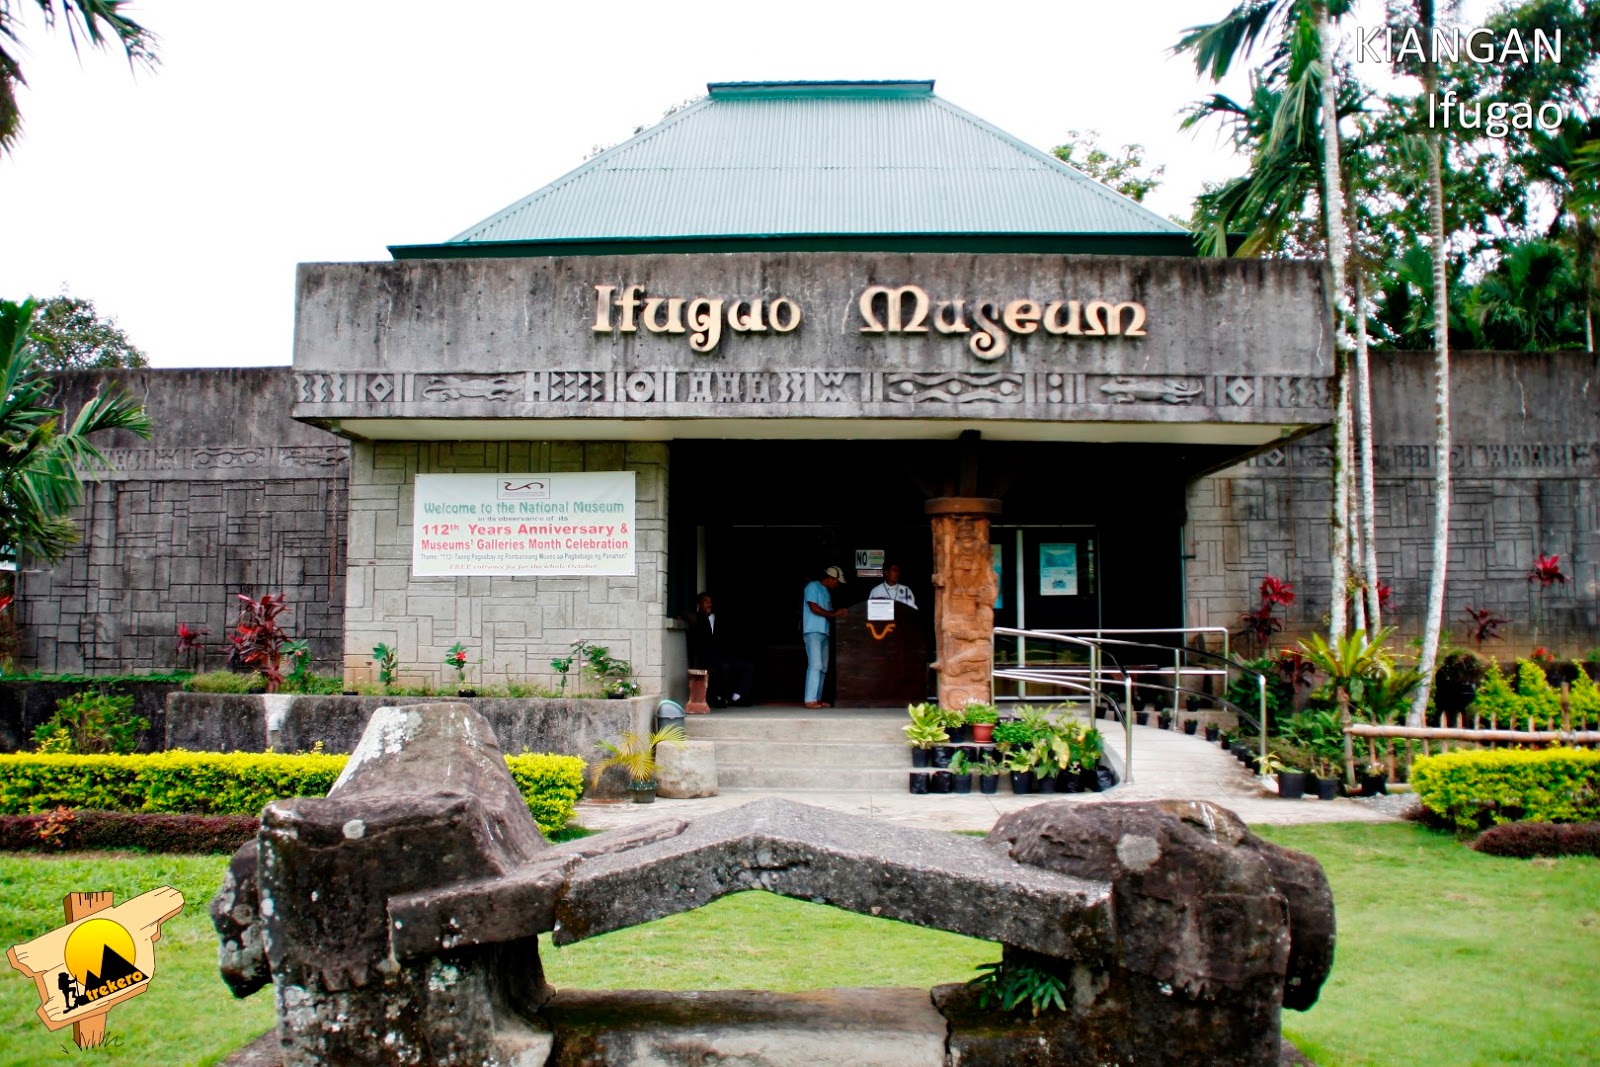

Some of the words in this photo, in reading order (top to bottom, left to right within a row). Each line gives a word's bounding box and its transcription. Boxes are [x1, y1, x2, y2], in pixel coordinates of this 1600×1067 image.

[591, 284, 802, 353] Ifugao
[859, 284, 1147, 361] Museum
[424, 502, 476, 514] Welcome
[481, 502, 492, 514] to
[497, 501, 515, 514] the
[519, 501, 569, 513] National
[573, 501, 624, 513] Museum
[422, 524, 459, 535] 112th
[467, 524, 512, 535] Years
[517, 523, 614, 536] Anniversary
[620, 522, 628, 534] &
[421, 539, 474, 550] Museums'
[477, 538, 525, 550] Galleries
[528, 538, 562, 549] Month
[565, 538, 629, 549] Celebration
[856, 551, 868, 566] NO
[517, 563, 528, 571] for
